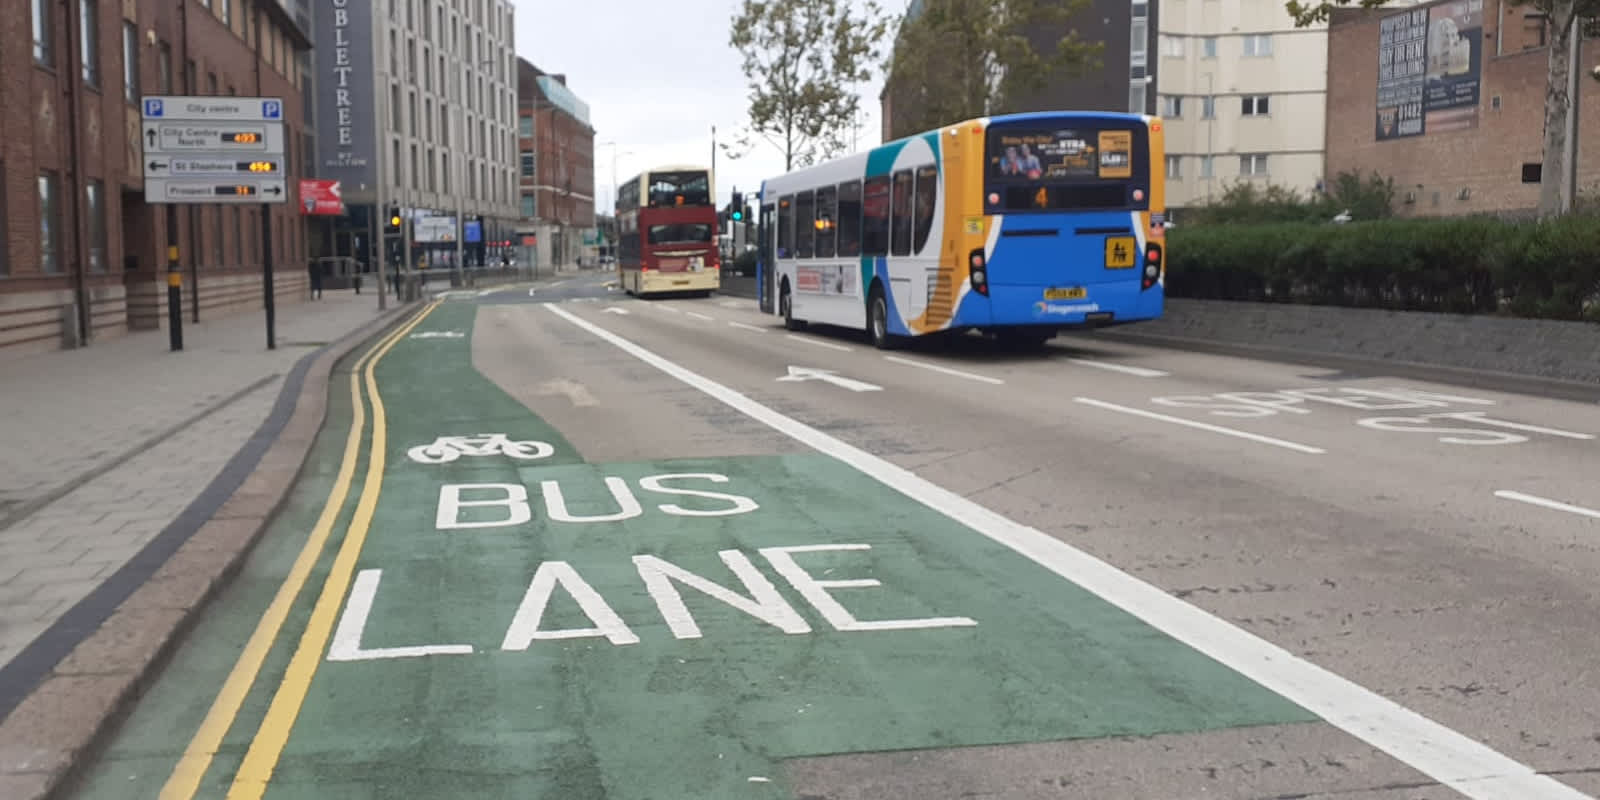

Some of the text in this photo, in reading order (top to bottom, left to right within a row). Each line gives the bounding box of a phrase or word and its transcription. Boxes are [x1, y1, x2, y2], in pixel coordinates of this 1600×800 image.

[187, 104, 206, 114] City
[164, 128, 219, 138] City Centre
[1035, 187, 1048, 208] 4
[435, 473, 760, 530] BUS
[325, 543, 979, 661] LANE
